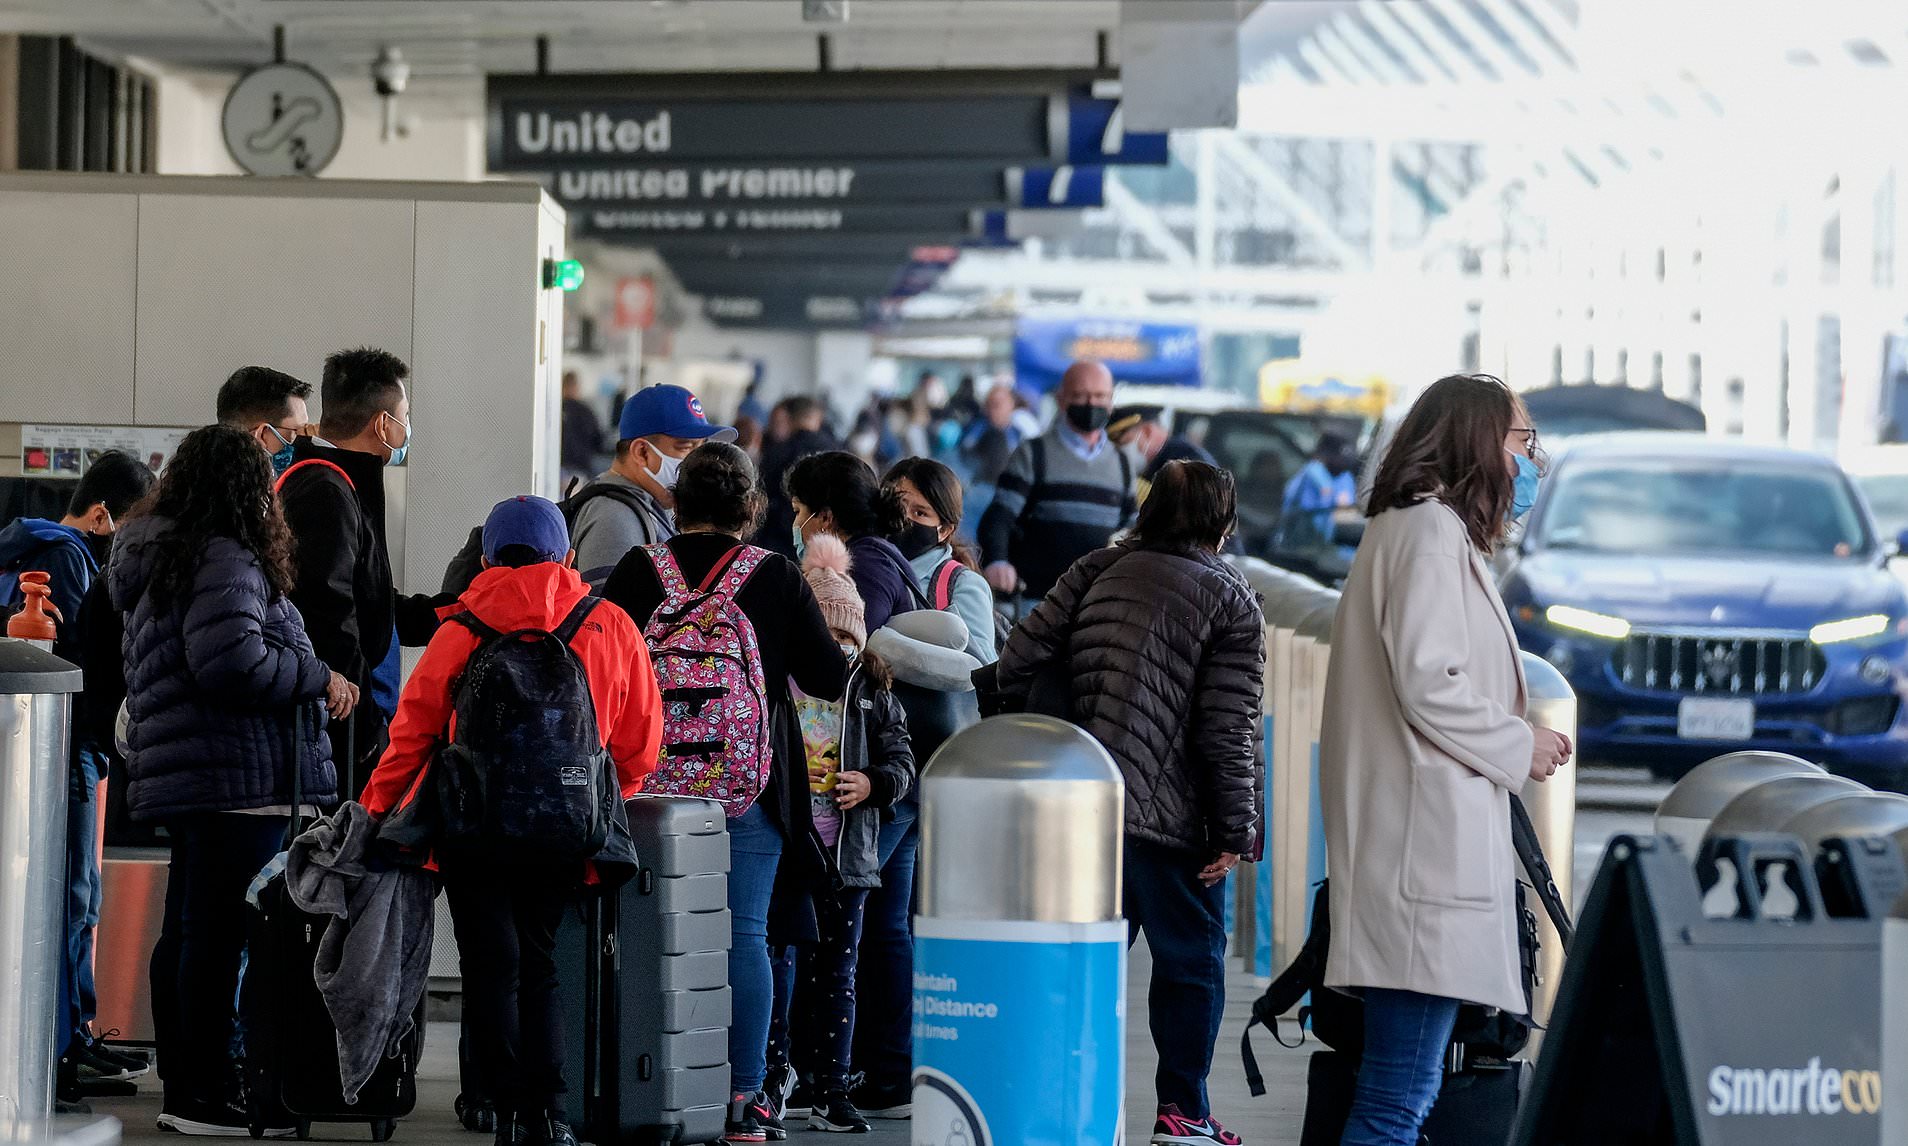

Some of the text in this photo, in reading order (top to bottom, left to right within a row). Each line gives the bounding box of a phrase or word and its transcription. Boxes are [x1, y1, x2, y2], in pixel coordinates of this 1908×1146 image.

[516, 110, 672, 152] United
[559, 167, 855, 200] United Premier
[925, 996, 998, 1018] Distance
